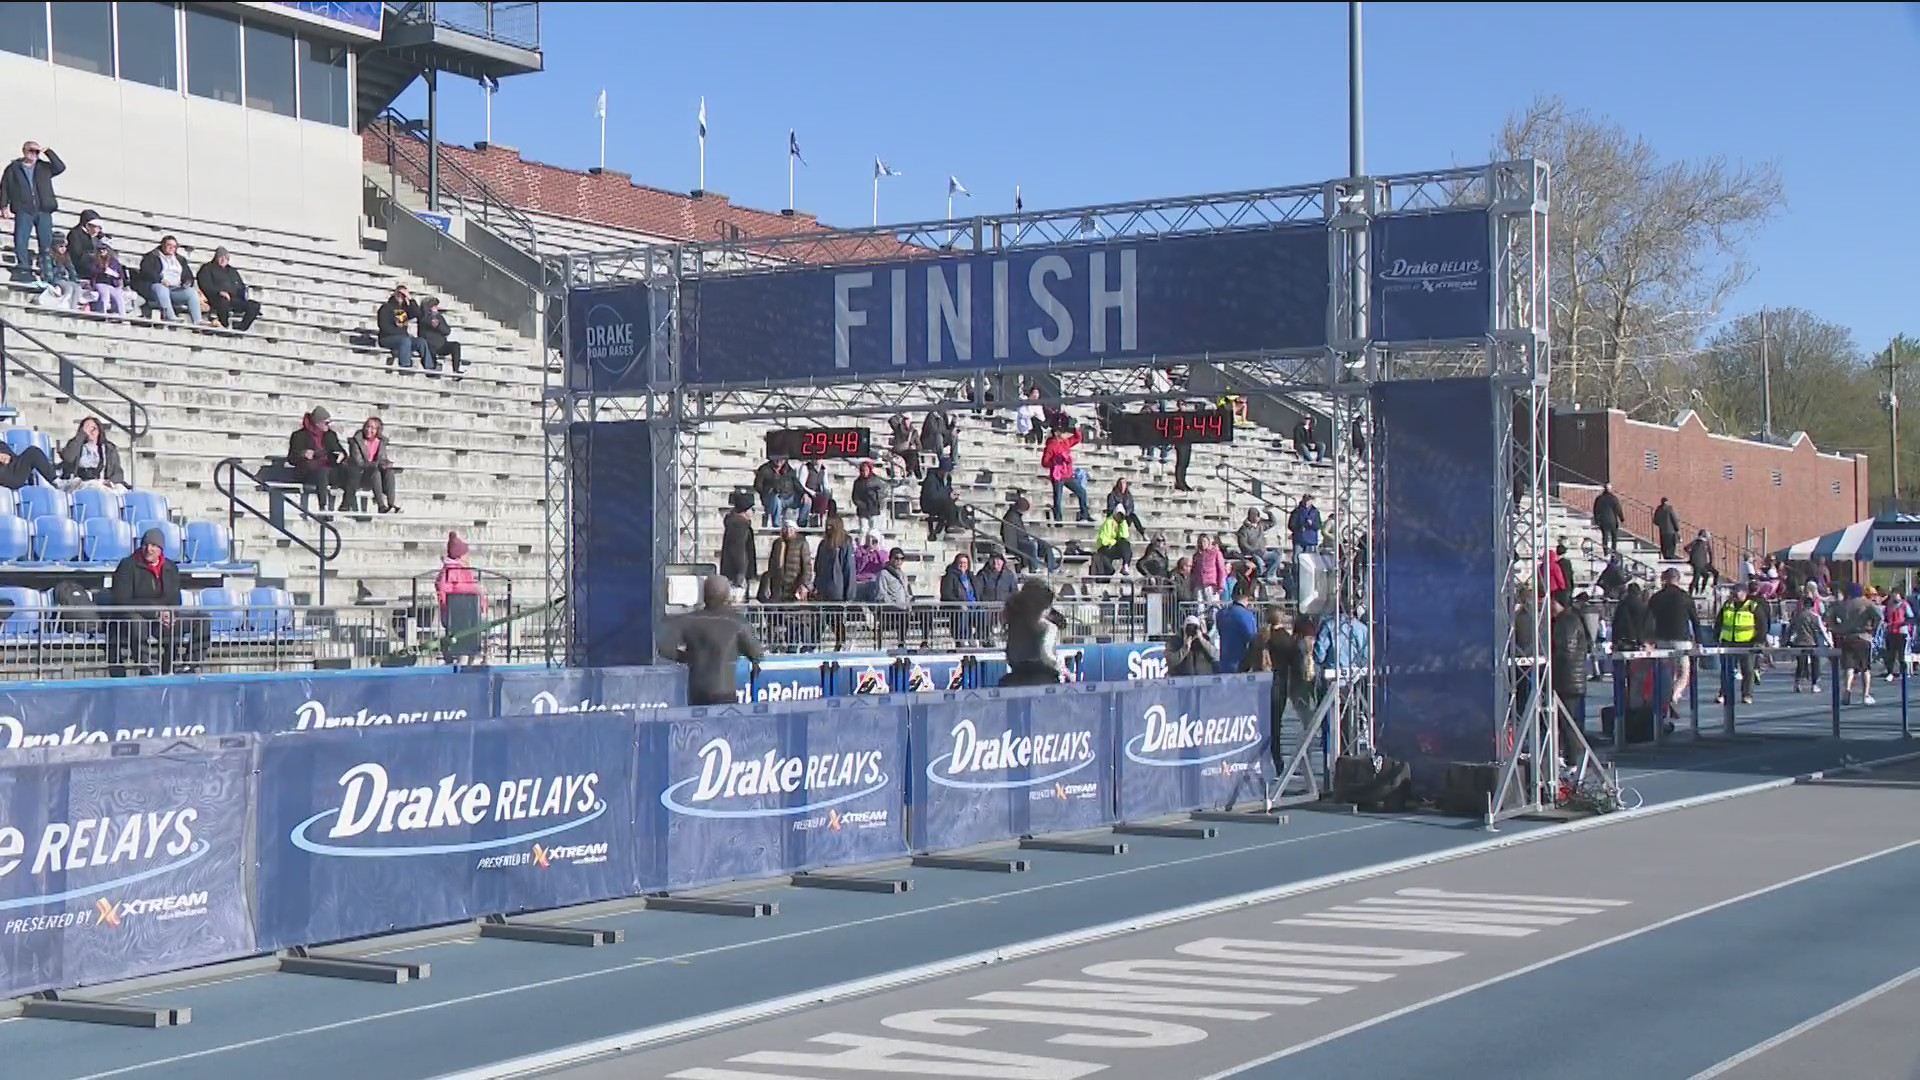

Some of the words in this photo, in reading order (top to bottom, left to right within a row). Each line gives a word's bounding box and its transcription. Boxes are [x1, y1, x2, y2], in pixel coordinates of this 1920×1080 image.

[1390, 258, 1438, 277] Drake
[1440, 259, 1480, 273] RELAYS
[834, 249, 1137, 368] FINISH
[586, 323, 633, 346] DRAKE
[609, 344, 634, 356] RACES
[947, 719, 1032, 774] Drake
[1032, 730, 1090, 765] RELAYS
[1141, 704, 1204, 752] Drake
[1204, 715, 1257, 745] RELAYS
[691, 737, 803, 801] Drake
[804, 750, 882, 790] RELAYS
[328, 762, 491, 838] Drake
[494, 772, 599, 822] RELAYS
[840, 810, 888, 824] XTREAM
[31, 808, 198, 875] RELAYS
[477, 853, 521, 870] PRESENTED
[548, 842, 608, 860] XTREAM
[4, 913, 74, 935] PRESENTED
[76, 909, 93, 925] BY
[120, 890, 208, 918] XTREAM
